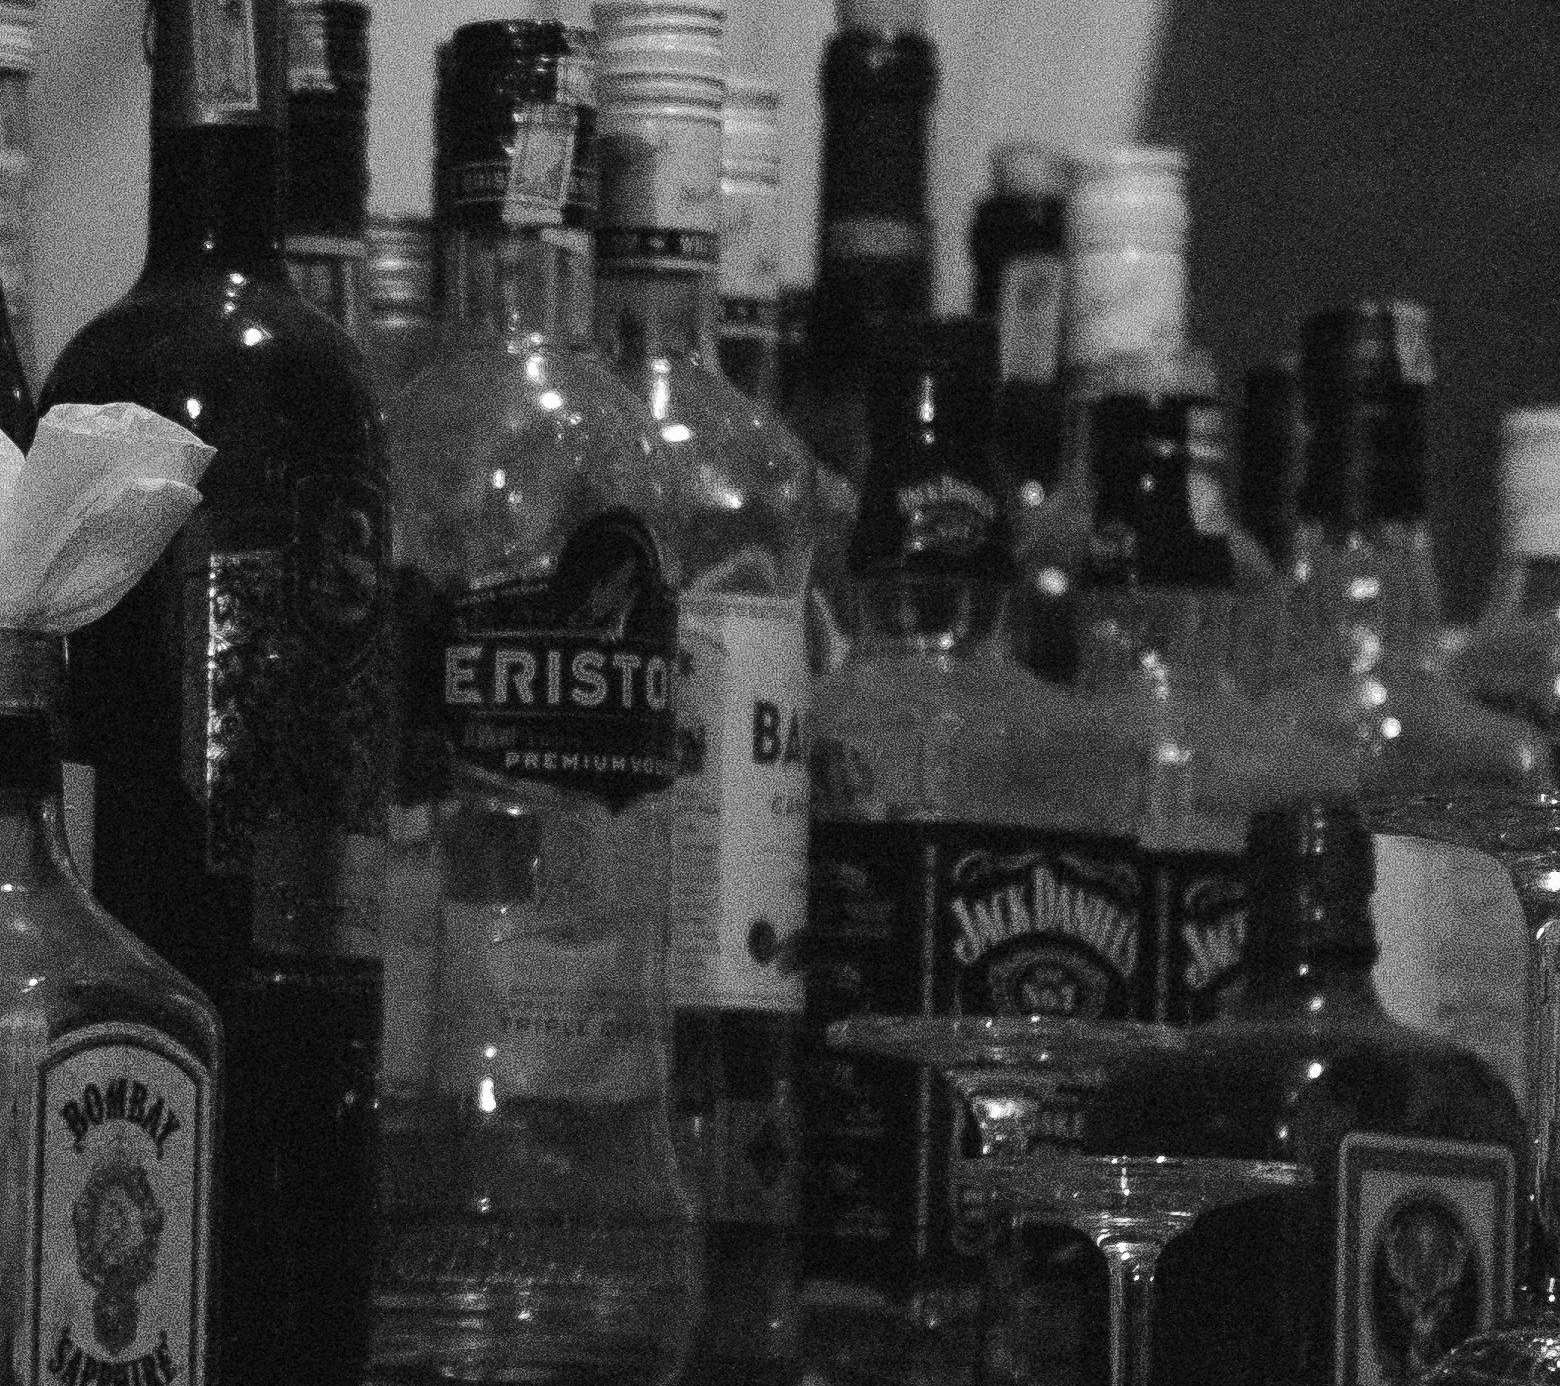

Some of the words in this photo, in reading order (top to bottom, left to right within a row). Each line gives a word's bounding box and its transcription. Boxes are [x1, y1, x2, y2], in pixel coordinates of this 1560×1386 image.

[445, 646, 668, 710] ERISTO
[504, 751, 626, 772] PREMIUM
[951, 885, 1030, 965] JACK
[62, 1079, 180, 1160] BOMBAY
